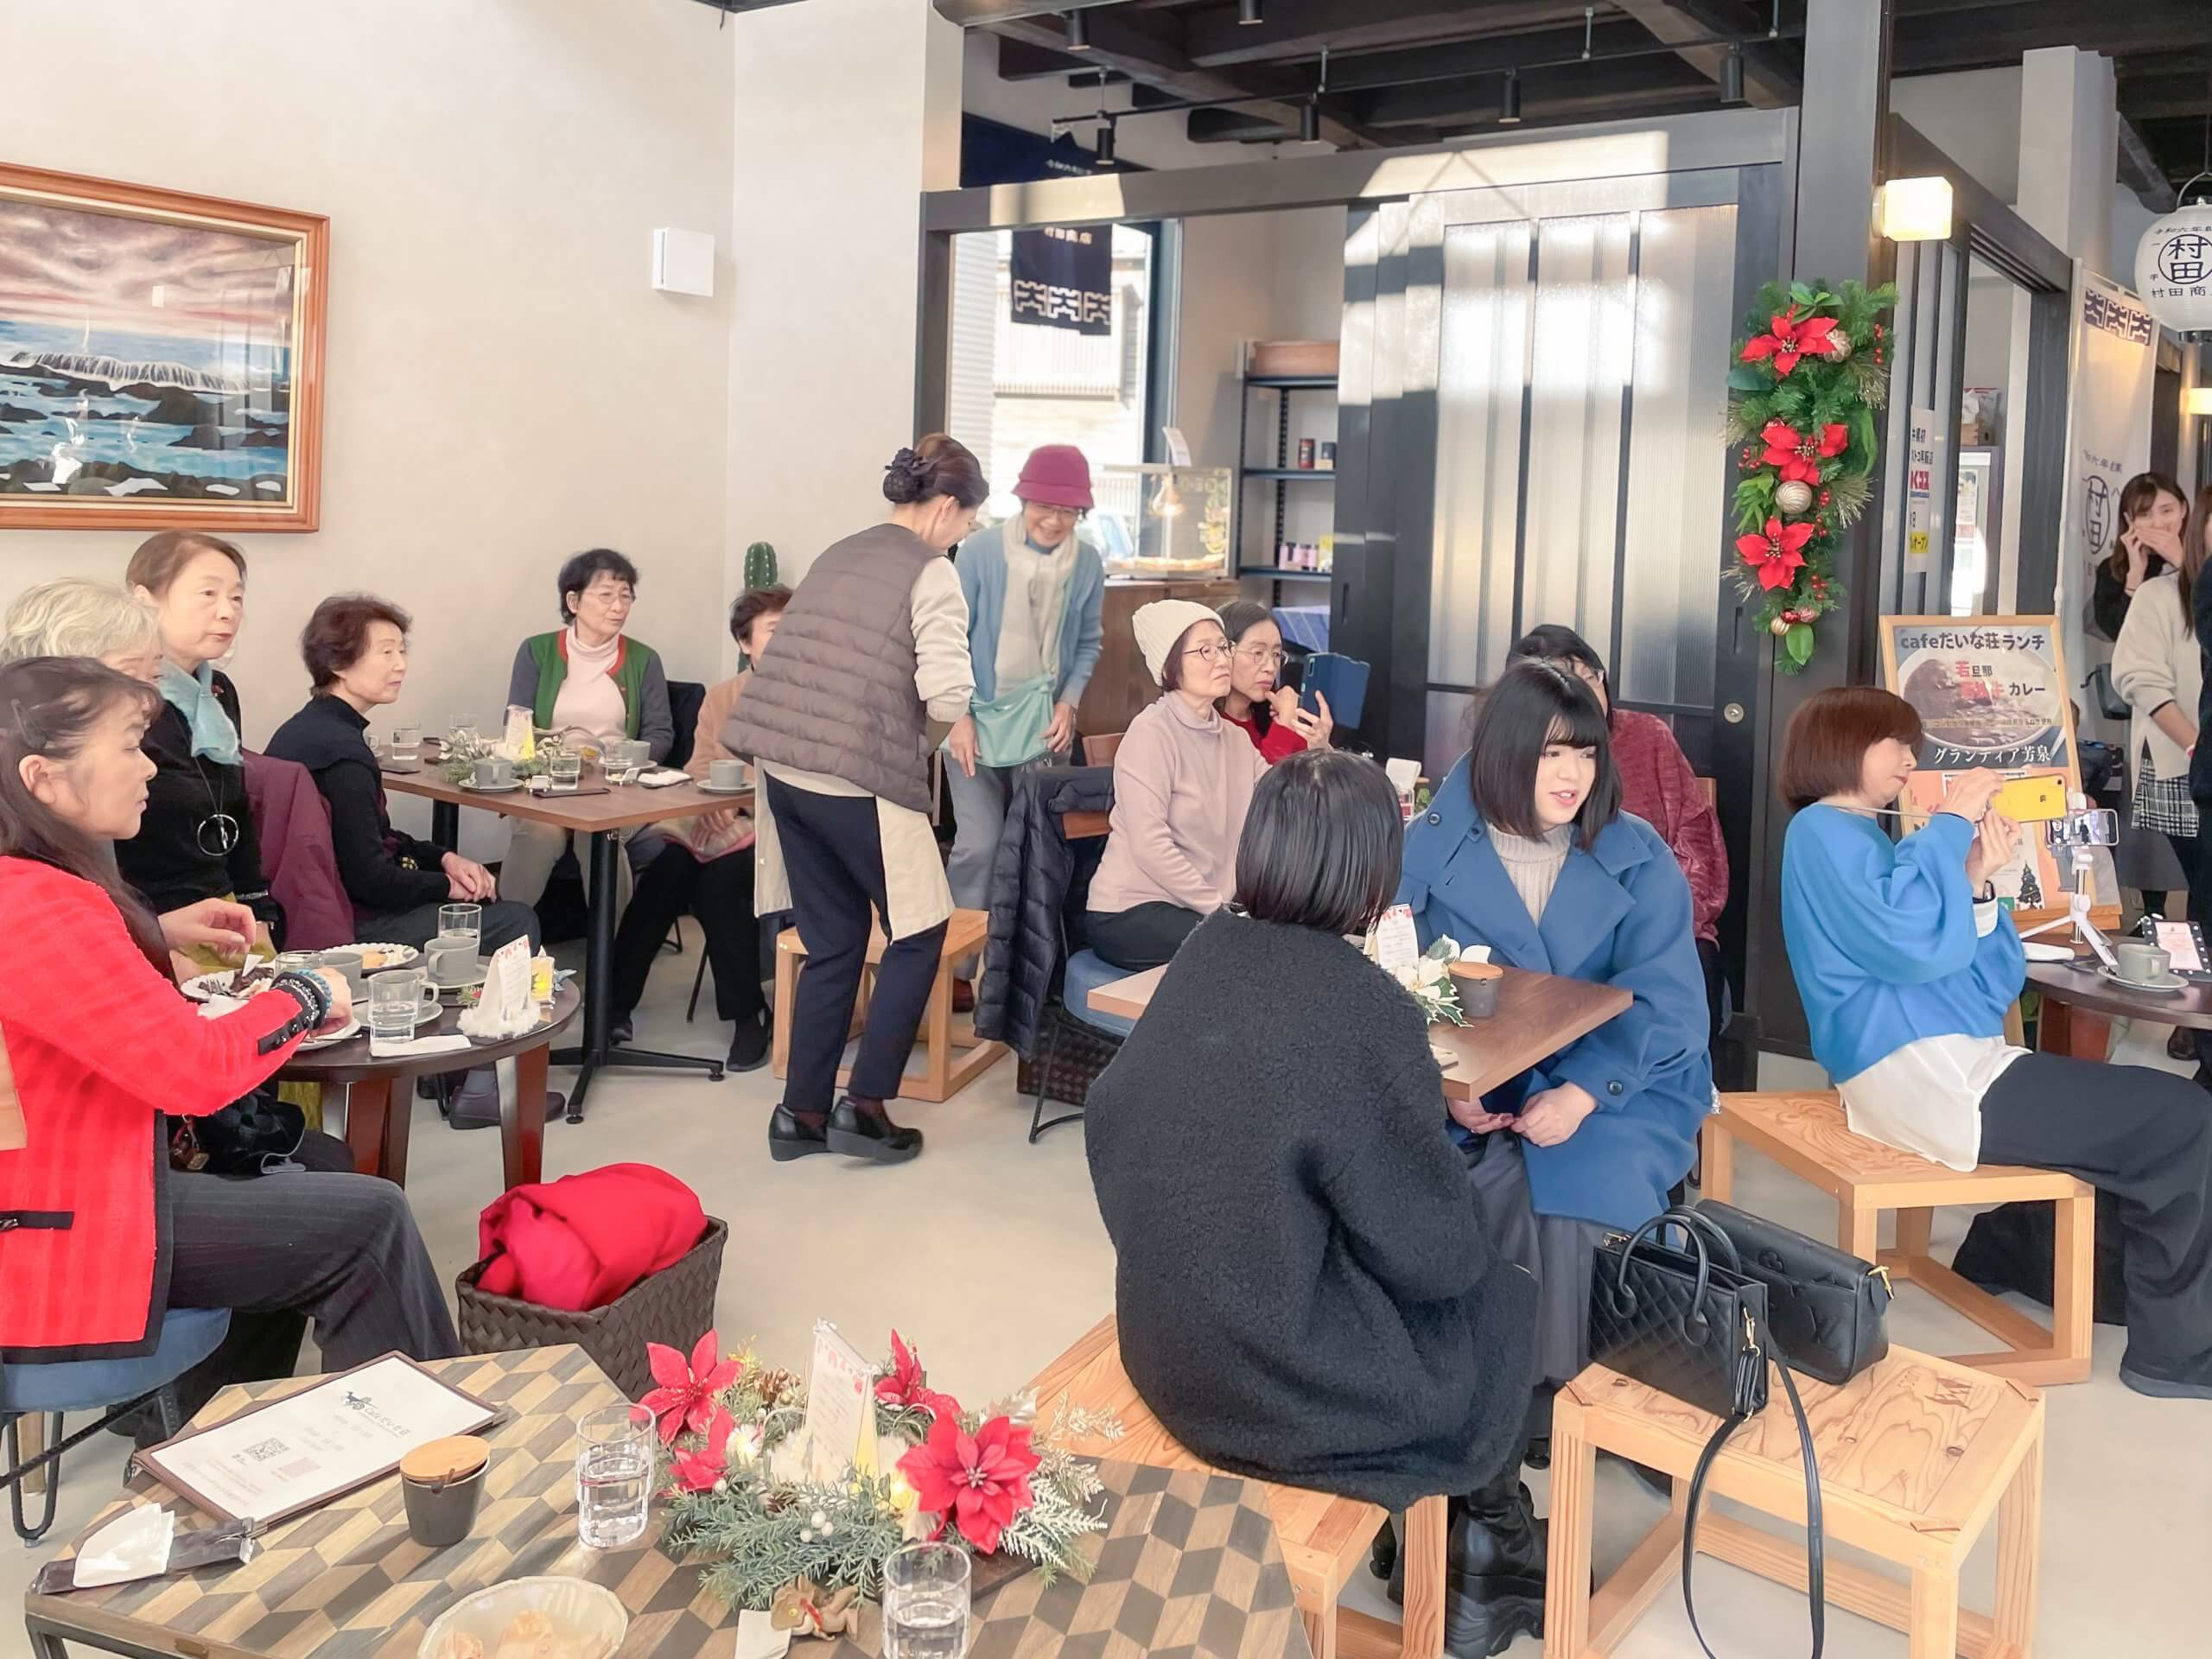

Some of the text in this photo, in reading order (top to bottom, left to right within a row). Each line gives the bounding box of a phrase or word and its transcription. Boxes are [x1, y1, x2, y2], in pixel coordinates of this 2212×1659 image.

[2167, 238, 2208, 280] 村田
[2151, 285, 2212, 297] 村田商
[2009, 683, 2046, 696] カレー
